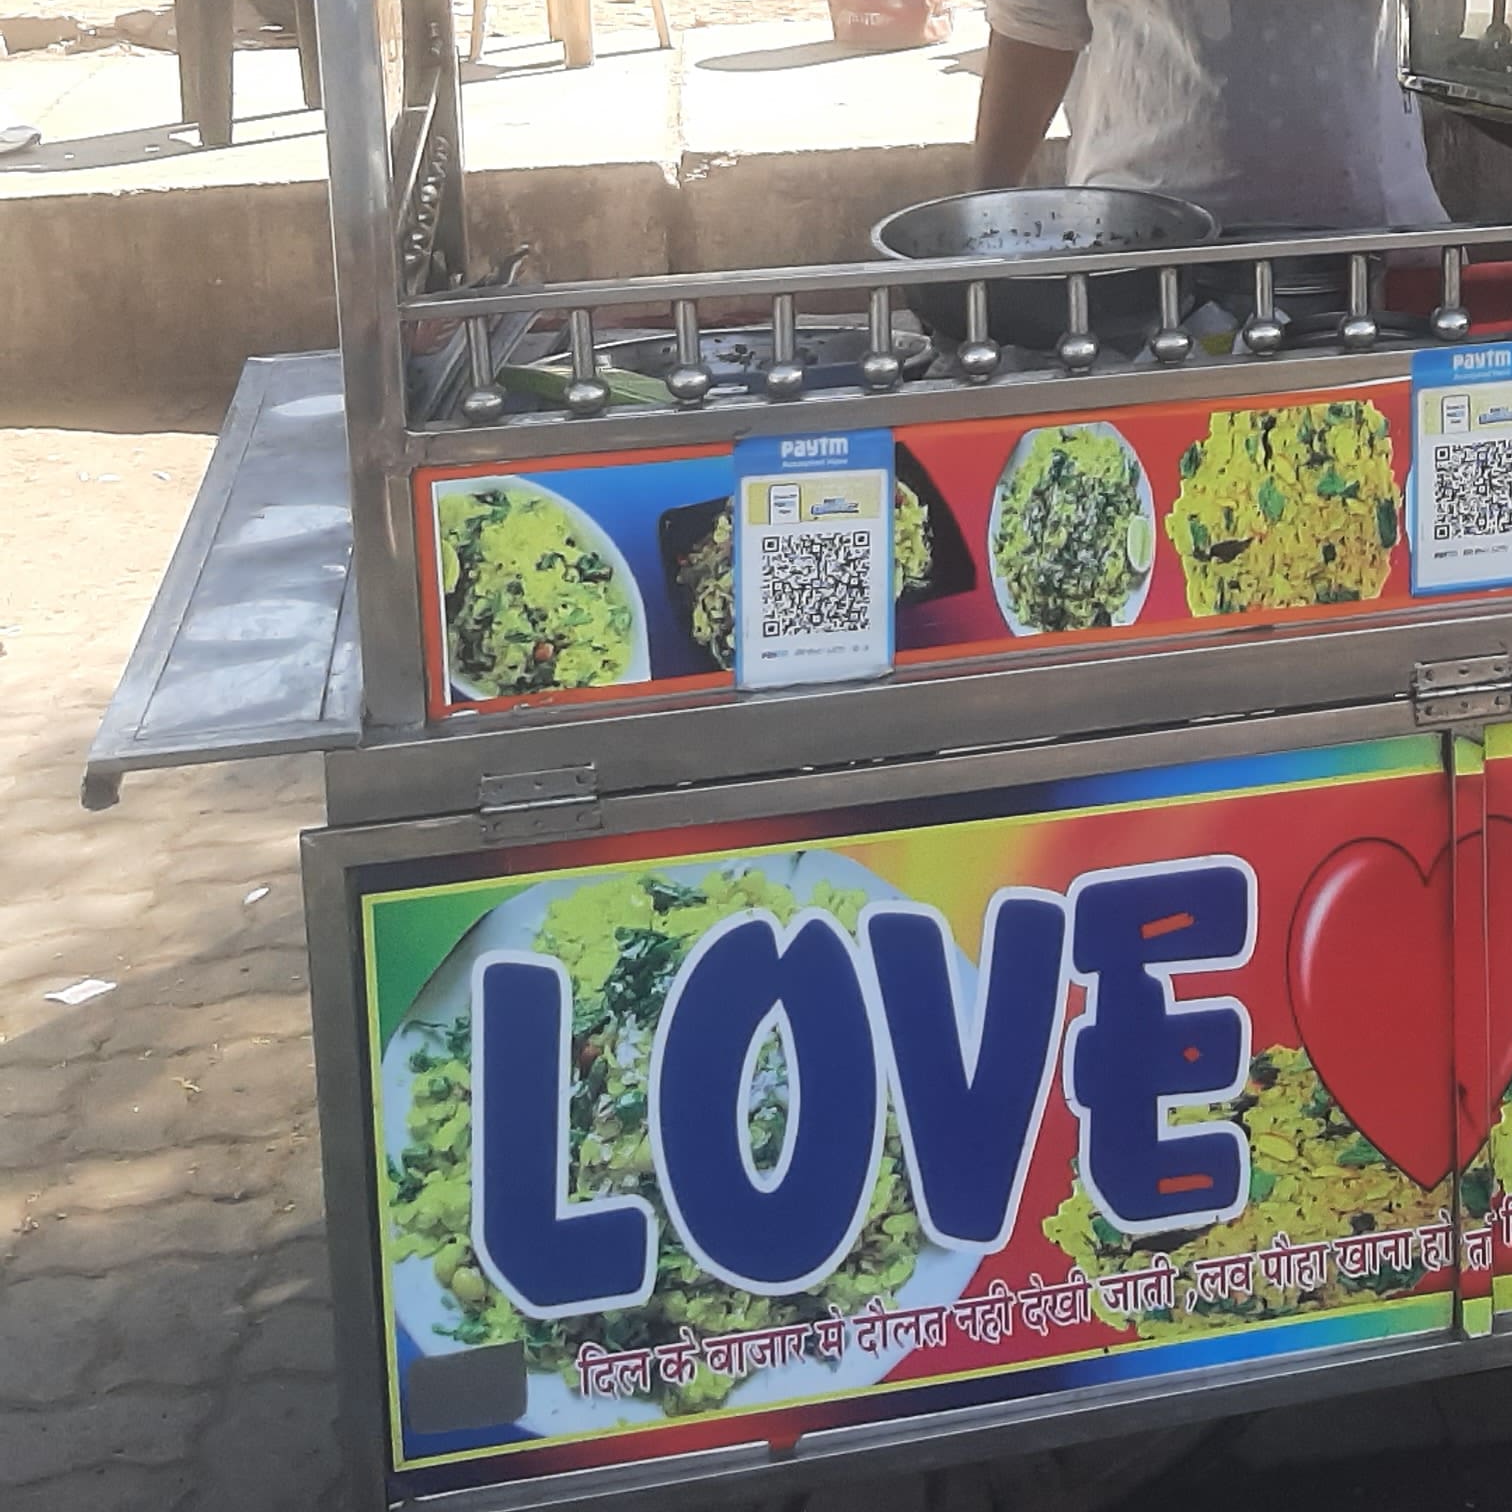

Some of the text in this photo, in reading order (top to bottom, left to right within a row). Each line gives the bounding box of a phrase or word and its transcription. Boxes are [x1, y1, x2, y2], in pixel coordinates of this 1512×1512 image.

[470, 854, 1258, 1320] LOVE
[578, 1342, 651, 1399] दिल
[656, 1326, 700, 1386] के
[704, 1322, 812, 1377] बाजार
[850, 1294, 949, 1361] दौलत
[1018, 1267, 1093, 1337] देखी
[1334, 1224, 1415, 1278] खाना
